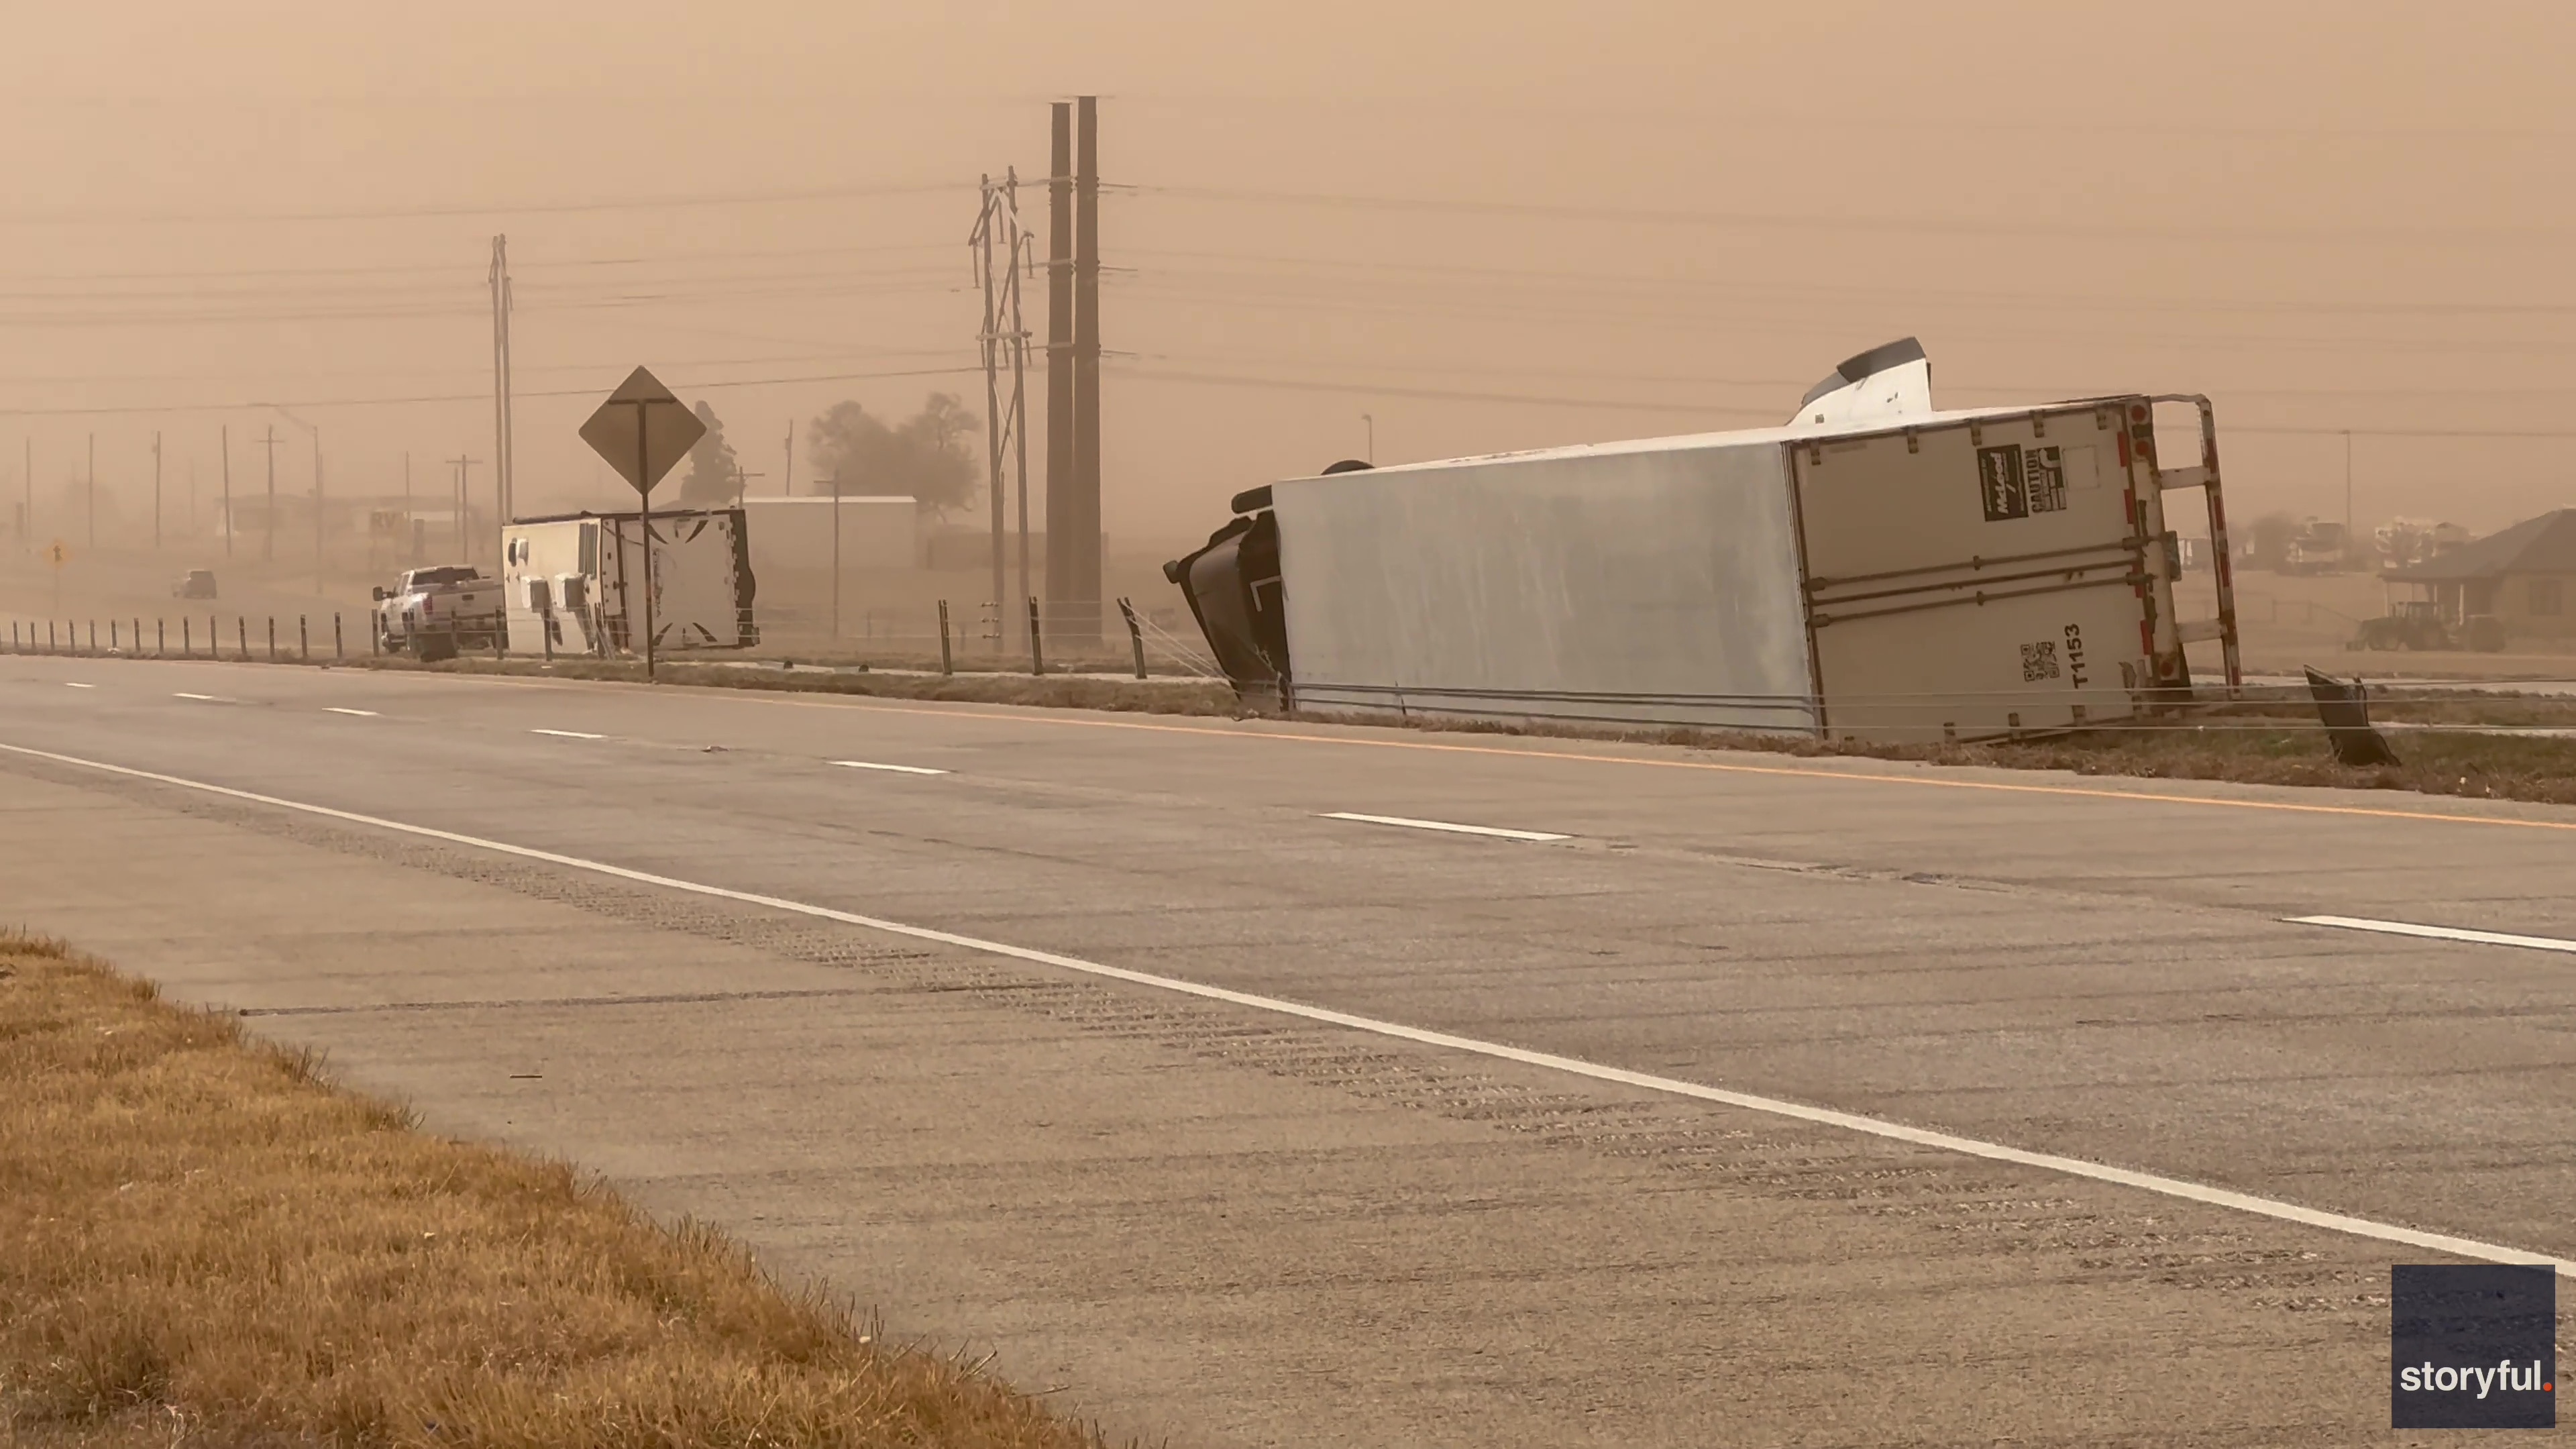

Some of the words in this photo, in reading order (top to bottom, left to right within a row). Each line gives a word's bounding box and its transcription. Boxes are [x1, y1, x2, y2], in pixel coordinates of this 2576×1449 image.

[1990, 452, 2017, 514] McLeod
[2025, 449, 2044, 513] CAUTION
[2064, 623, 2088, 690] T1153
